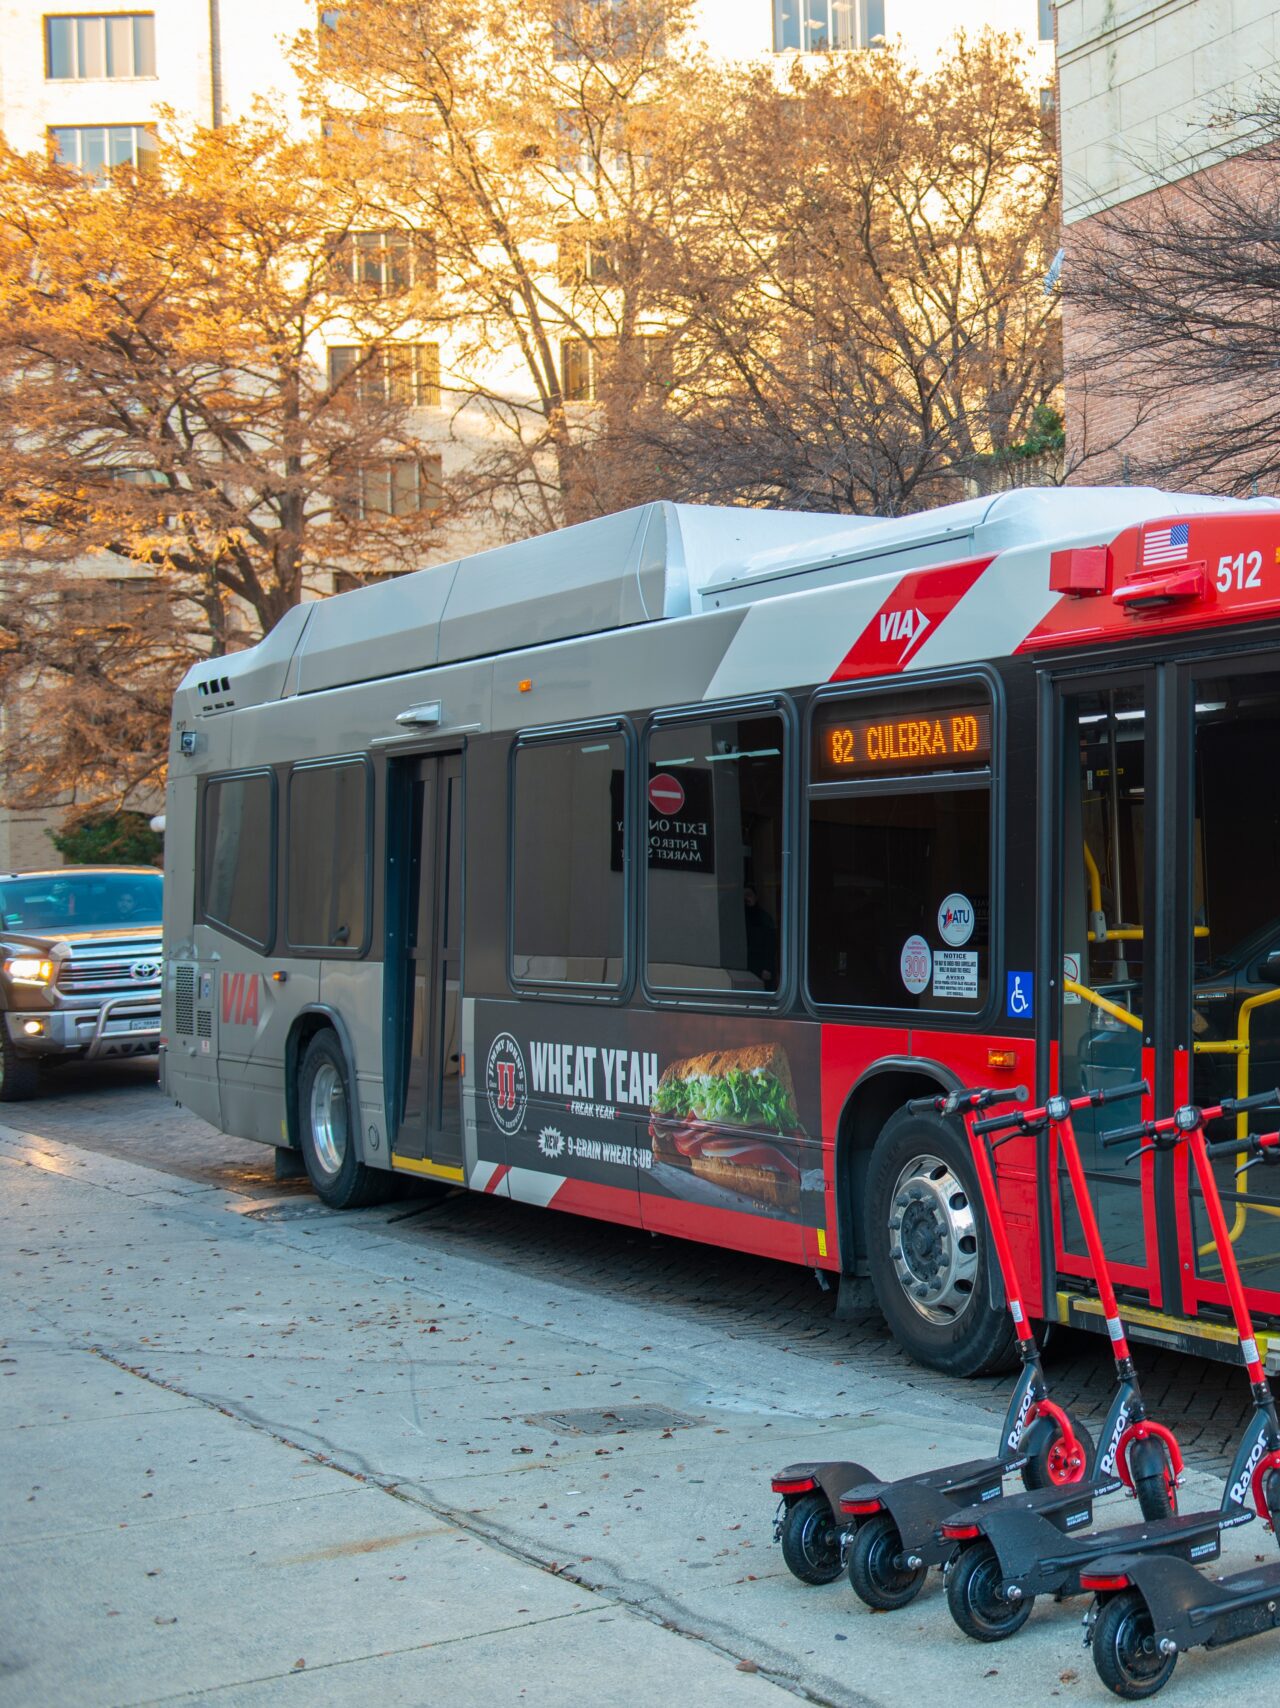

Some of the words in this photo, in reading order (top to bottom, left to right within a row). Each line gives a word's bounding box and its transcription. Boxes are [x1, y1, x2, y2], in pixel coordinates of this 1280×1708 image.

[1216, 551, 1262, 592] 512
[880, 609, 914, 642] VIA
[831, 729, 854, 763] 82
[867, 719, 946, 760] CULEBRA
[953, 716, 978, 753] RD
[952, 909, 970, 924] ATU
[905, 955, 928, 977] 300
[222, 972, 259, 1026] VIA
[488, 1039, 505, 1078] JIMMY
[530, 1041, 597, 1099] WHEAT
[601, 1047, 658, 1106] YEAH
[571, 1101, 594, 1117] FREAK
[595, 1105, 615, 1120] YEAH
[544, 1134, 561, 1150] NEW
[567, 1136, 601, 1161] 9-GRAIN
[602, 1142, 632, 1166] WHEAT
[633, 1147, 653, 1169] SUB
[1008, 1381, 1035, 1450] Razor
[1100, 1401, 1130, 1474] Razor
[1230, 1429, 1268, 1504] Razor
